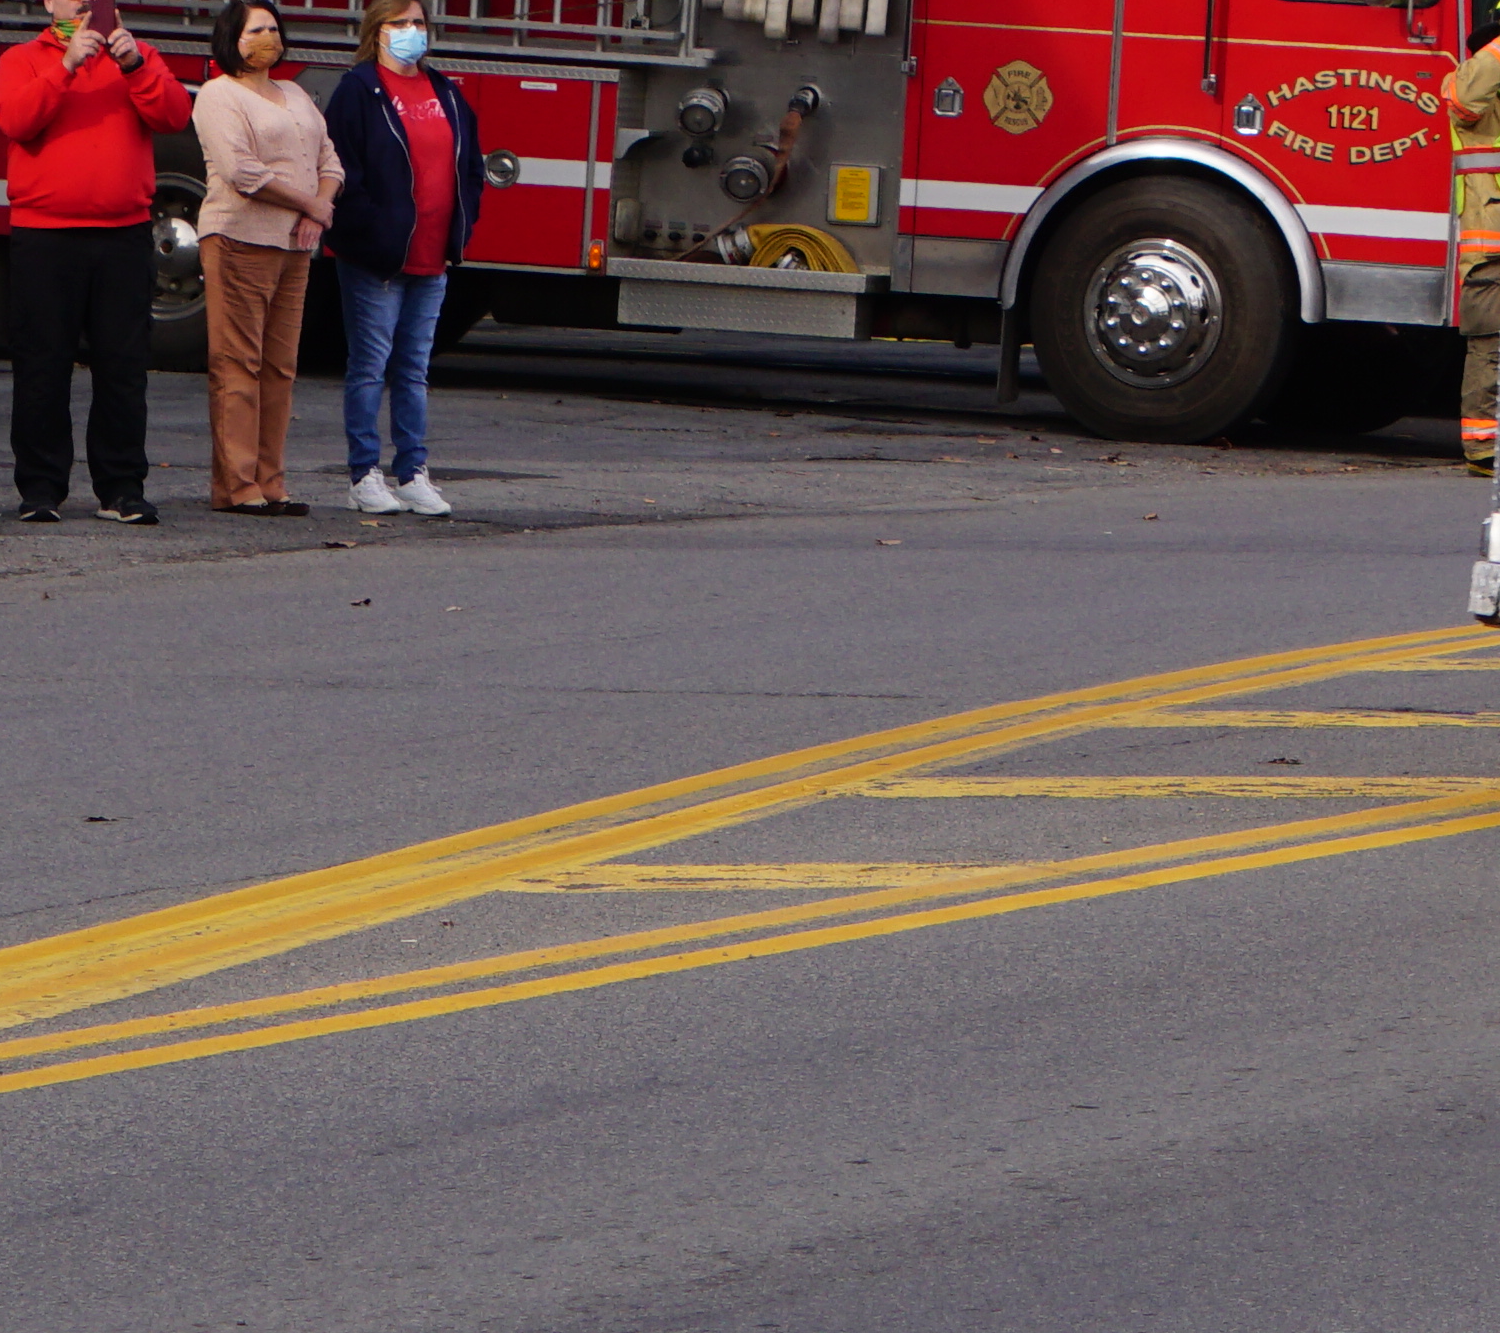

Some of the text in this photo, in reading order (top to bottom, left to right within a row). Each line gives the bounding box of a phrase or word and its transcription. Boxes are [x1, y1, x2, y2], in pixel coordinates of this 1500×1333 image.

[1007, 69, 1032, 80] FIRE
[1267, 68, 1441, 114] HASTINGS
[1326, 104, 1379, 130] 1121
[1267, 120, 1441, 165] FIRE DEPT.
